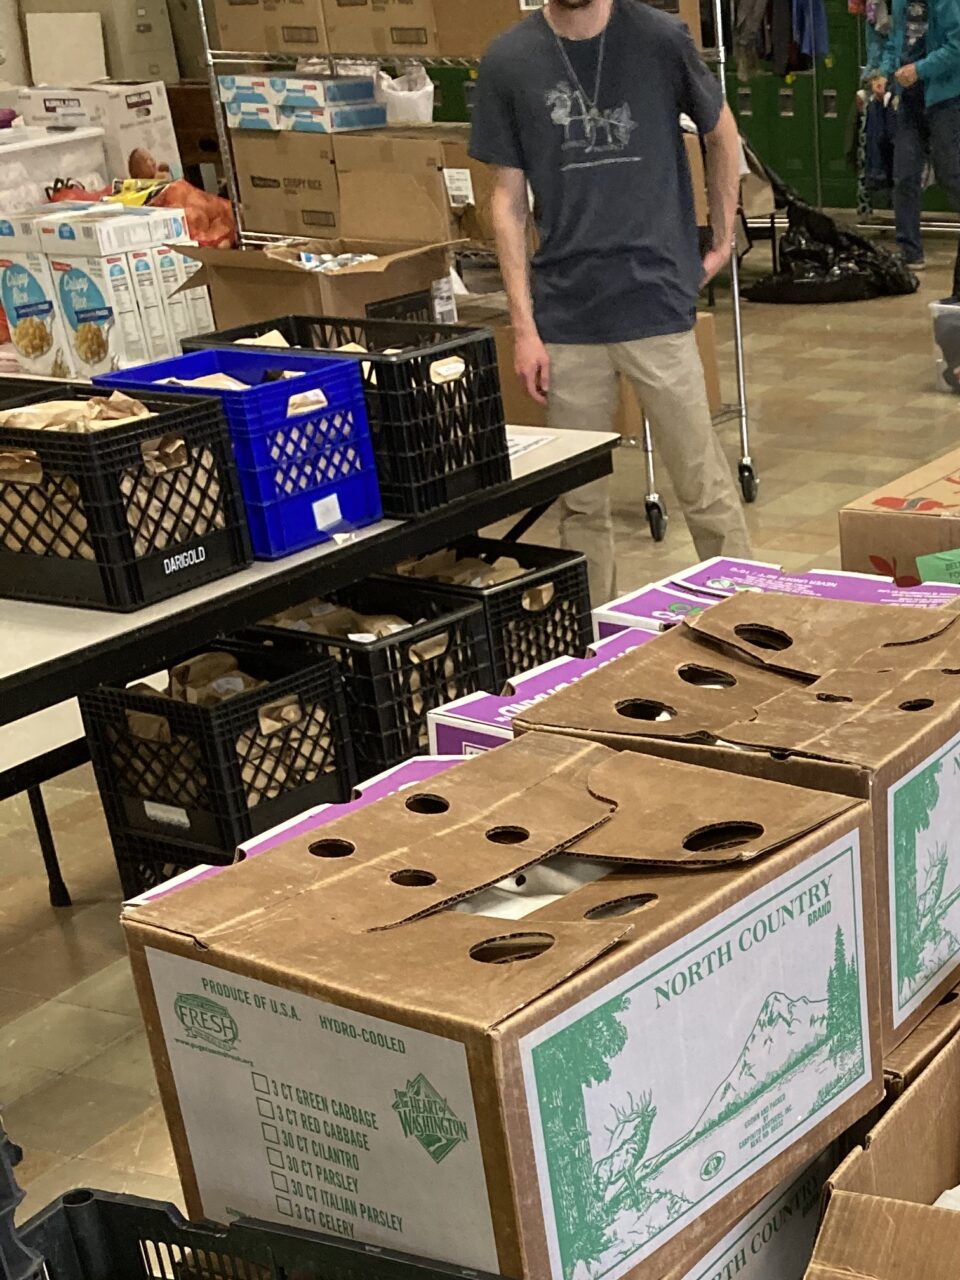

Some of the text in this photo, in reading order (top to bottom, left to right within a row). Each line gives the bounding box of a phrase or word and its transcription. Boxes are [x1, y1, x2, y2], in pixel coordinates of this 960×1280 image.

[164, 546, 206, 574] DARIGOLD
[808, 901, 832, 927] BRAND
[653, 874, 833, 1009] NORTH COUNTRY
[201, 977, 252, 1005] PRODUCE
[253, 993, 267, 1010] OF
[269, 998, 302, 1021] U.S.A.
[179, 1005, 236, 1037] FRESH
[319, 1015, 406, 1054] HYDRO-COOLED
[272, 1080, 379, 1130] 3 CT GREEN CABBAGE
[277, 1105, 370, 1151] 3 CT RED CABBAGE
[398, 1109, 469, 1142] WASHINGTON
[281, 1130, 359, 1171] 30 CT CILANTRO
[286, 1155, 359, 1194] 30 CT PARSLEY
[291, 1179, 403, 1232] 30 CT ITALIAN PARSLEY
[295, 1203, 354, 1238] 3 CT CELERY
[750, 1171, 819, 1255] COUNTRY
